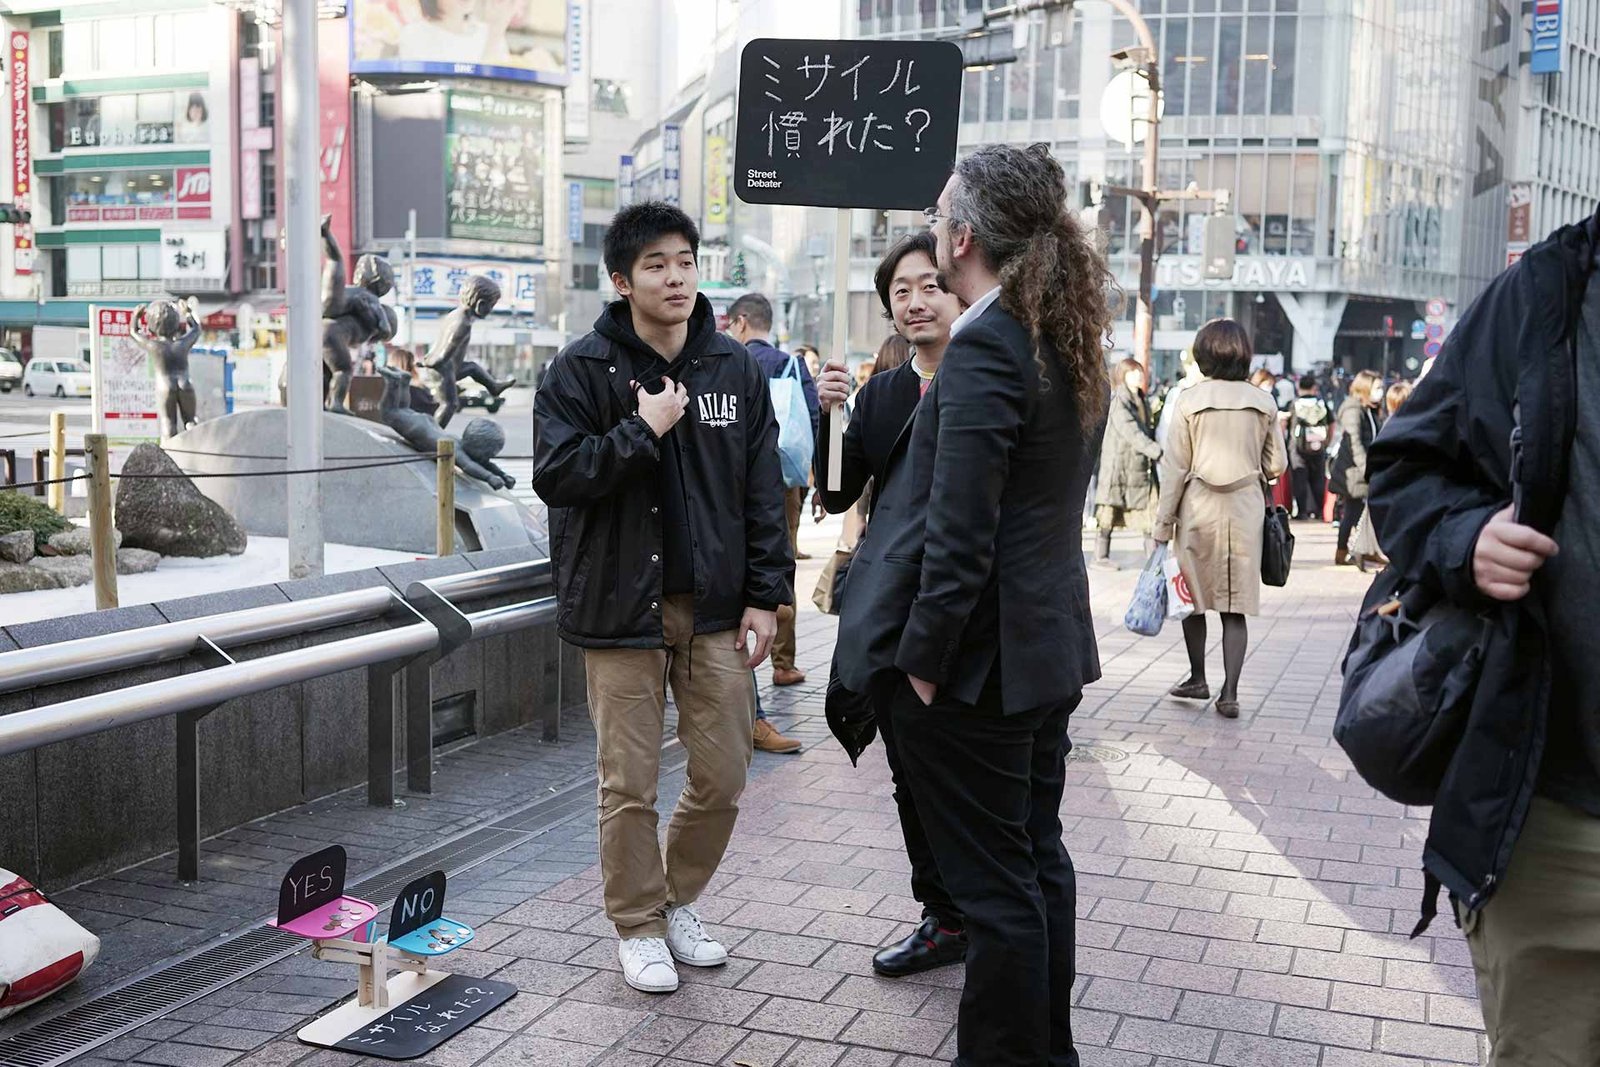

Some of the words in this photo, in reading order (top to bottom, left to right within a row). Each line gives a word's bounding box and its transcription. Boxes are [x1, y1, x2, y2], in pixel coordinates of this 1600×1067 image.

[763, 54, 921, 102] ミサイル
[761, 108, 931, 158] 慣れた?
[747, 169, 777, 179] Street
[747, 179, 782, 188] Debater
[1157, 258, 1308, 287] TSTAYA
[697, 393, 737, 420] ATLAS
[289, 865, 333, 906] YES
[401, 887, 435, 924] NO
[347, 1003, 431, 1045] ミサイル
[414, 986, 495, 1034] なれた?
